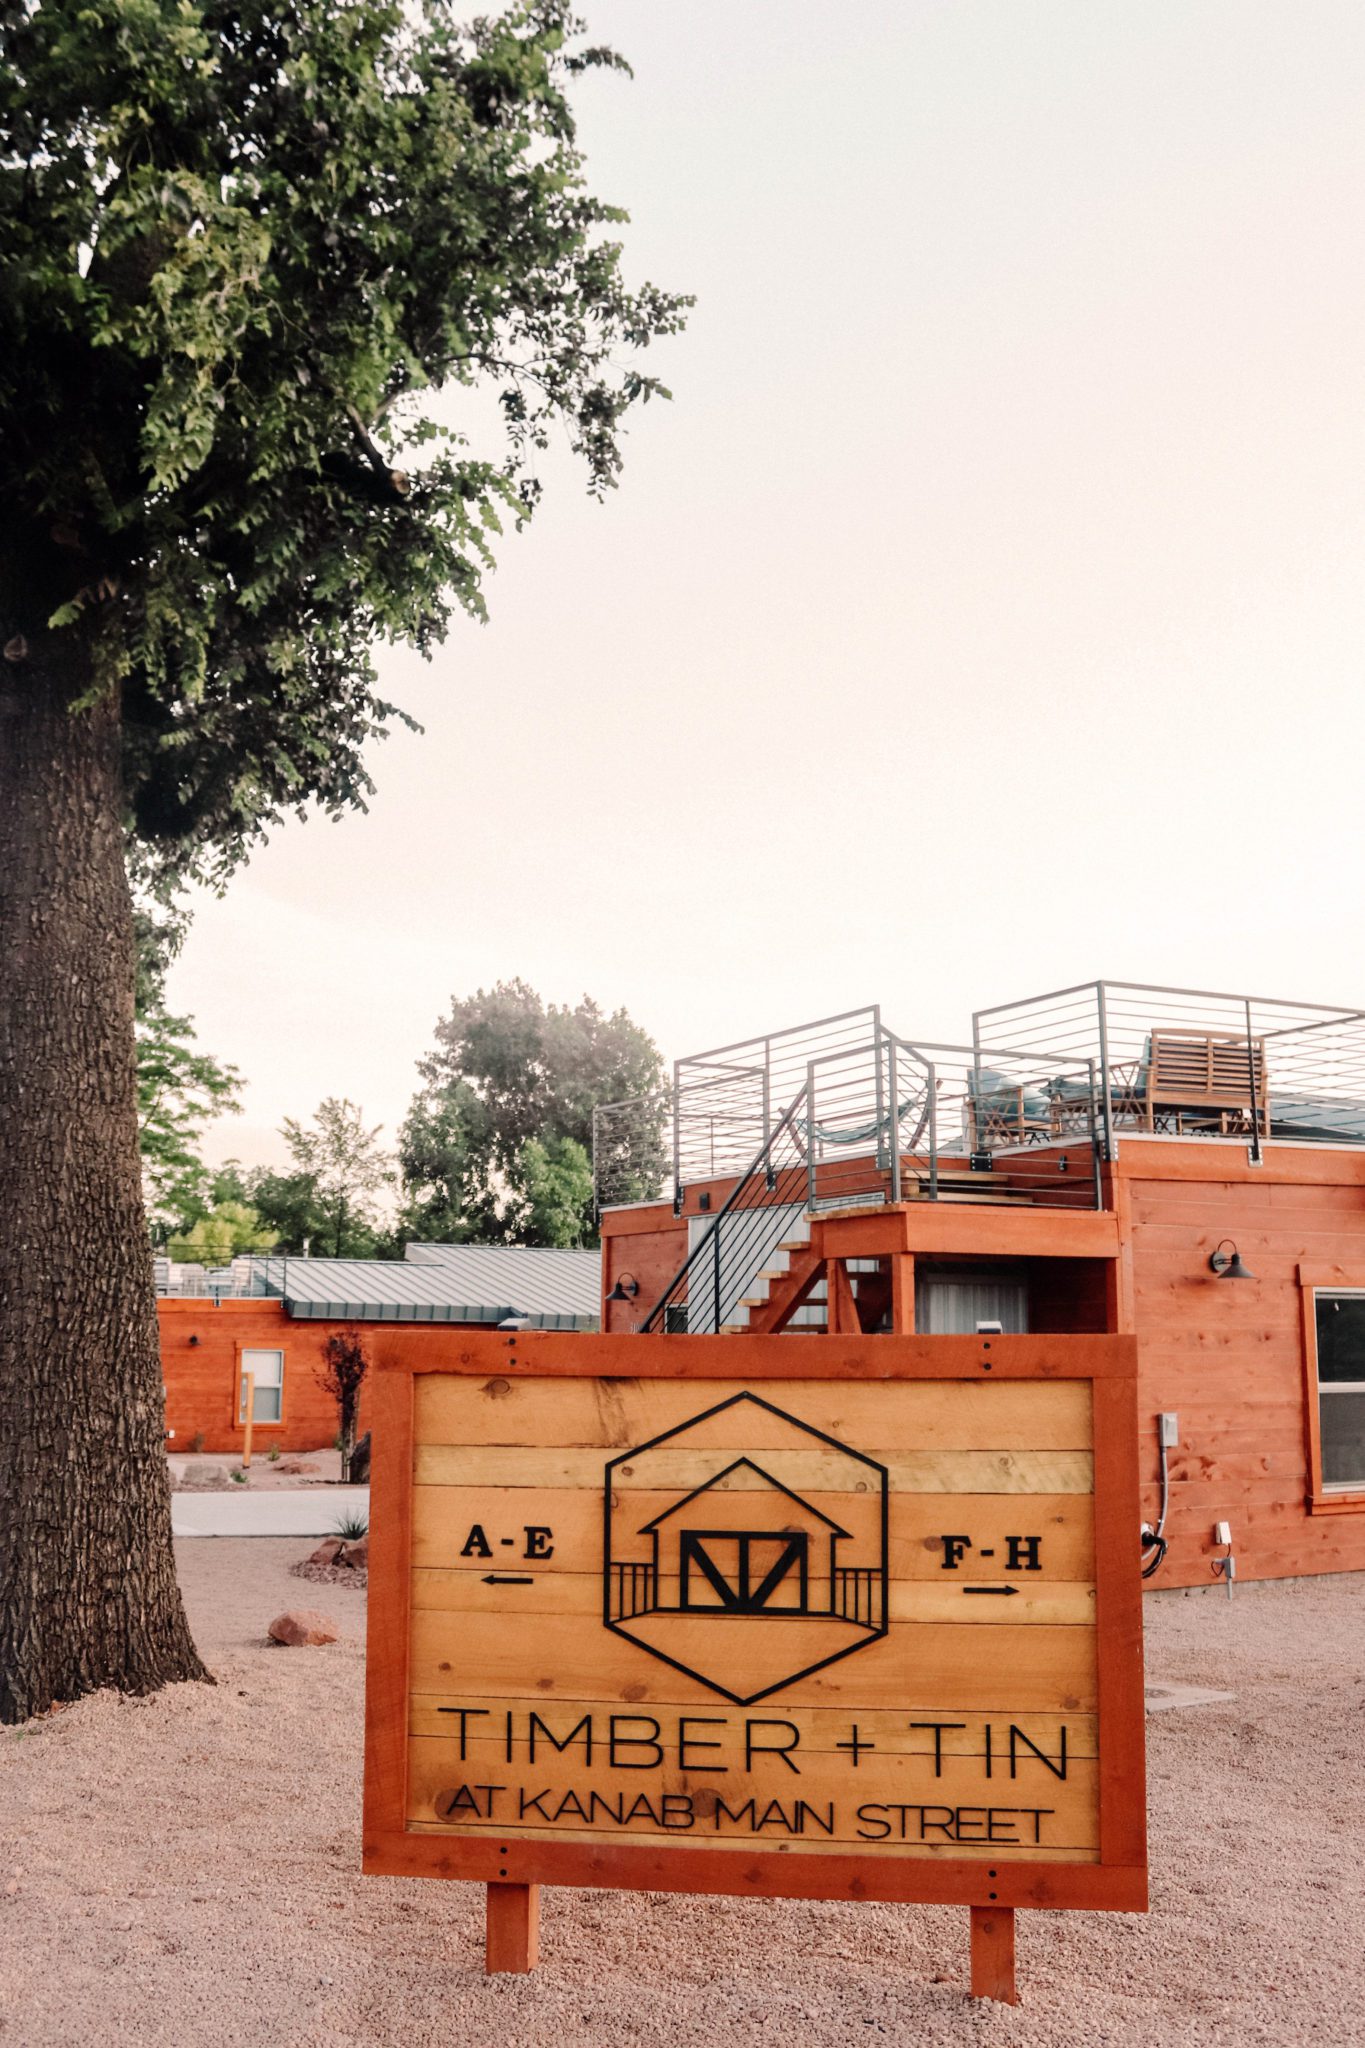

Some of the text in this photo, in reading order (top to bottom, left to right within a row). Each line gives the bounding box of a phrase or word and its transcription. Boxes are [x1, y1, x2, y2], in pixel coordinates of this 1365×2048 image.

[437, 1707, 1067, 1781] TIMBER + TIN
[446, 1784, 1056, 1844] AT KANAB MAIN STREET
